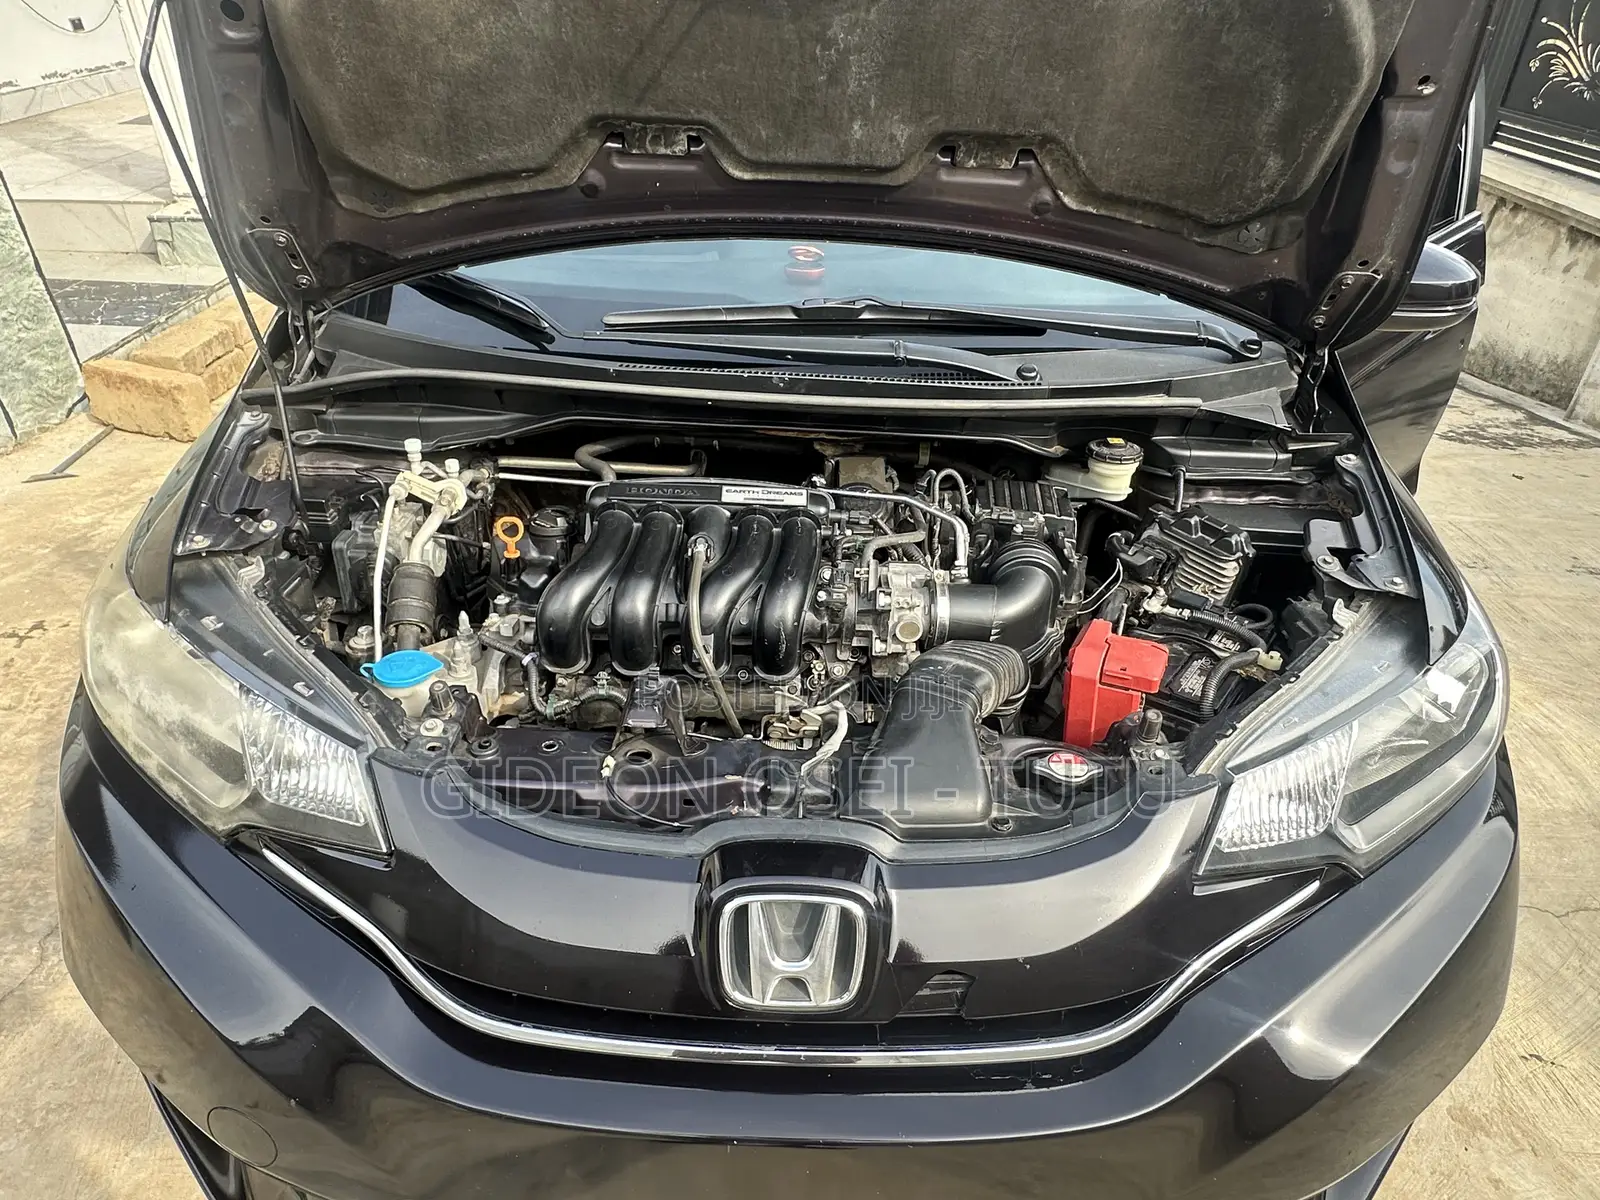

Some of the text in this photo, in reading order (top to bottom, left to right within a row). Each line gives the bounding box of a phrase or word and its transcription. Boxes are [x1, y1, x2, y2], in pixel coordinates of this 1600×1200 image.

[626, 486, 700, 497] HONDA
[725, 488, 804, 497] EARTH DREAMS
